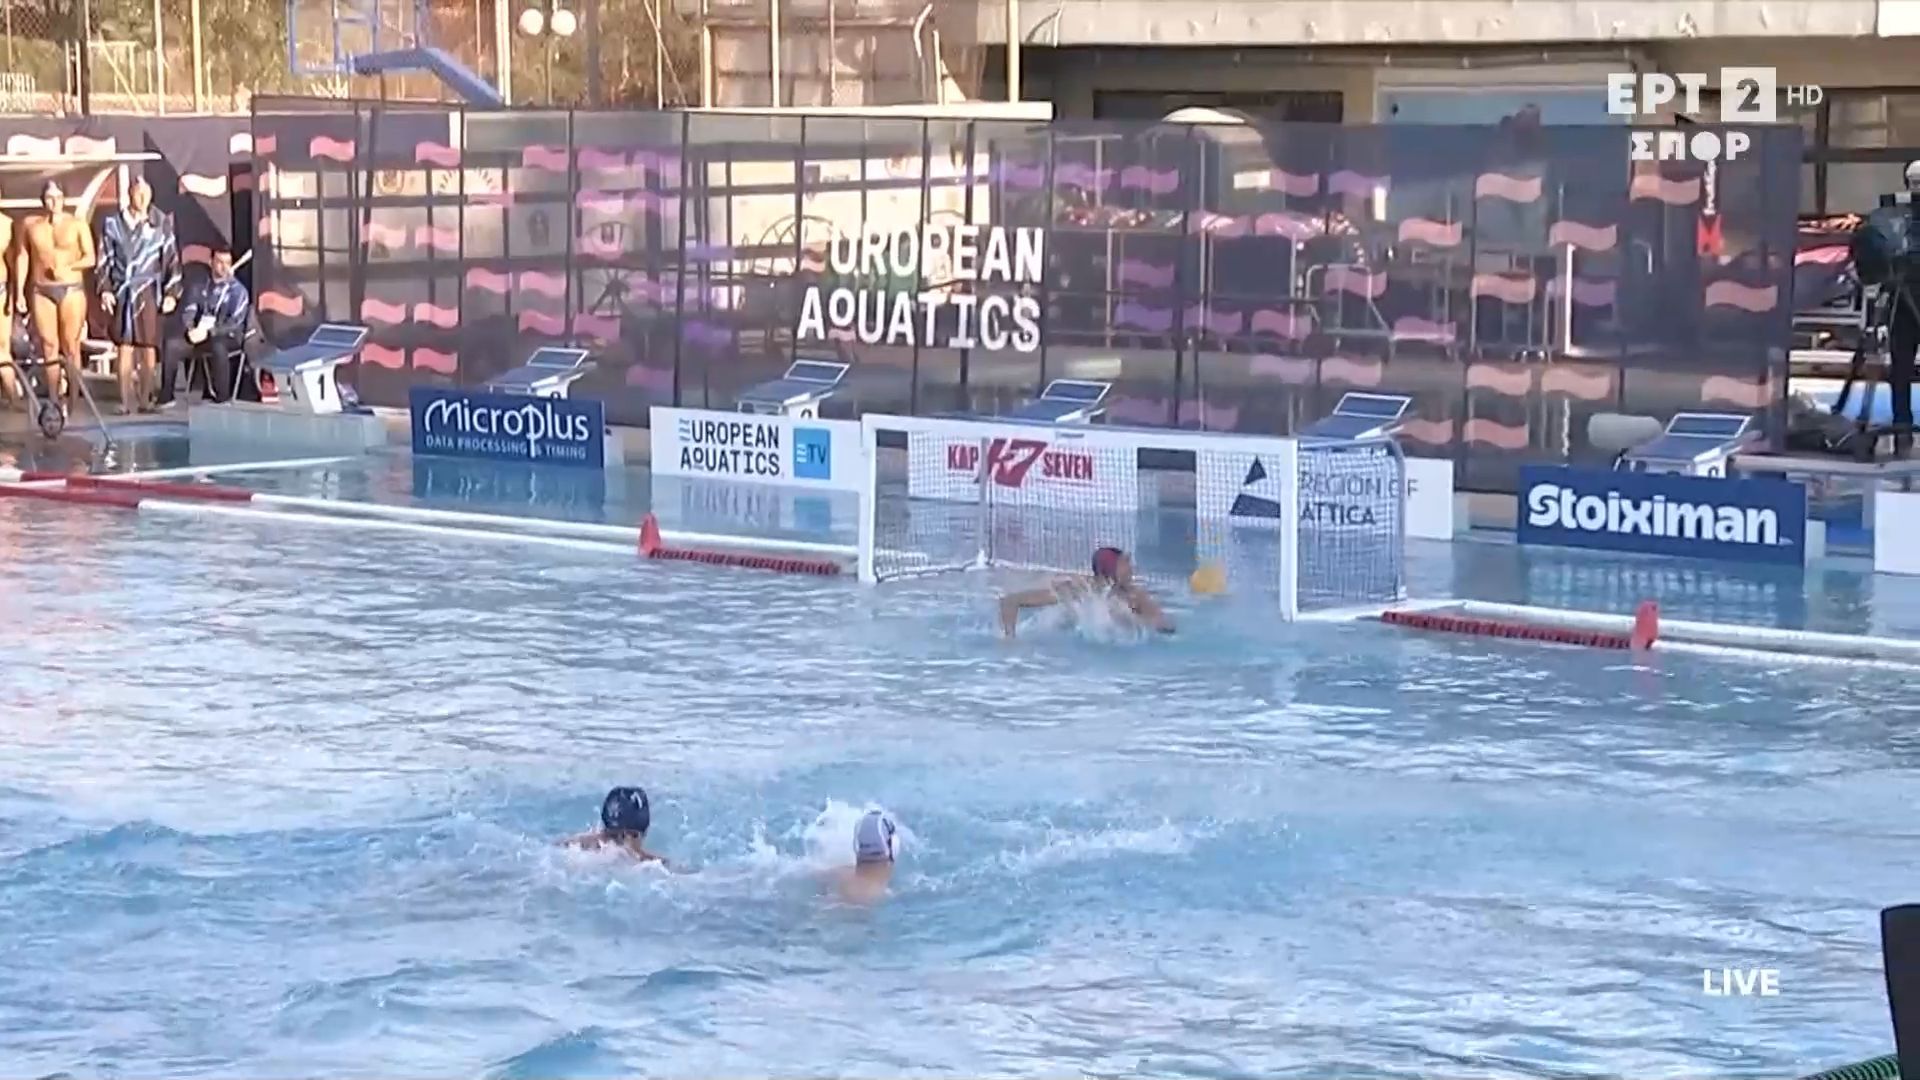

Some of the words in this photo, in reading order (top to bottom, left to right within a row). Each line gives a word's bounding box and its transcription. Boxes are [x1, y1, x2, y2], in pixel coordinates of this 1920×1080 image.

[796, 286, 1041, 352] AQUATICS
[318, 373, 325, 400] 1
[426, 435, 455, 450] DATA
[457, 437, 528, 456] PROCESSING
[546, 443, 587, 460] TIMING
[678, 417, 780, 449] EUROPEAN
[680, 446, 781, 476] AQUATICS
[947, 443, 979, 471] KAP
[1043, 451, 1093, 481] SEVEN
[1301, 472, 1381, 499] REGION
[1300, 502, 1377, 526] ATTICA
[1527, 483, 1779, 546] Stoiximan
